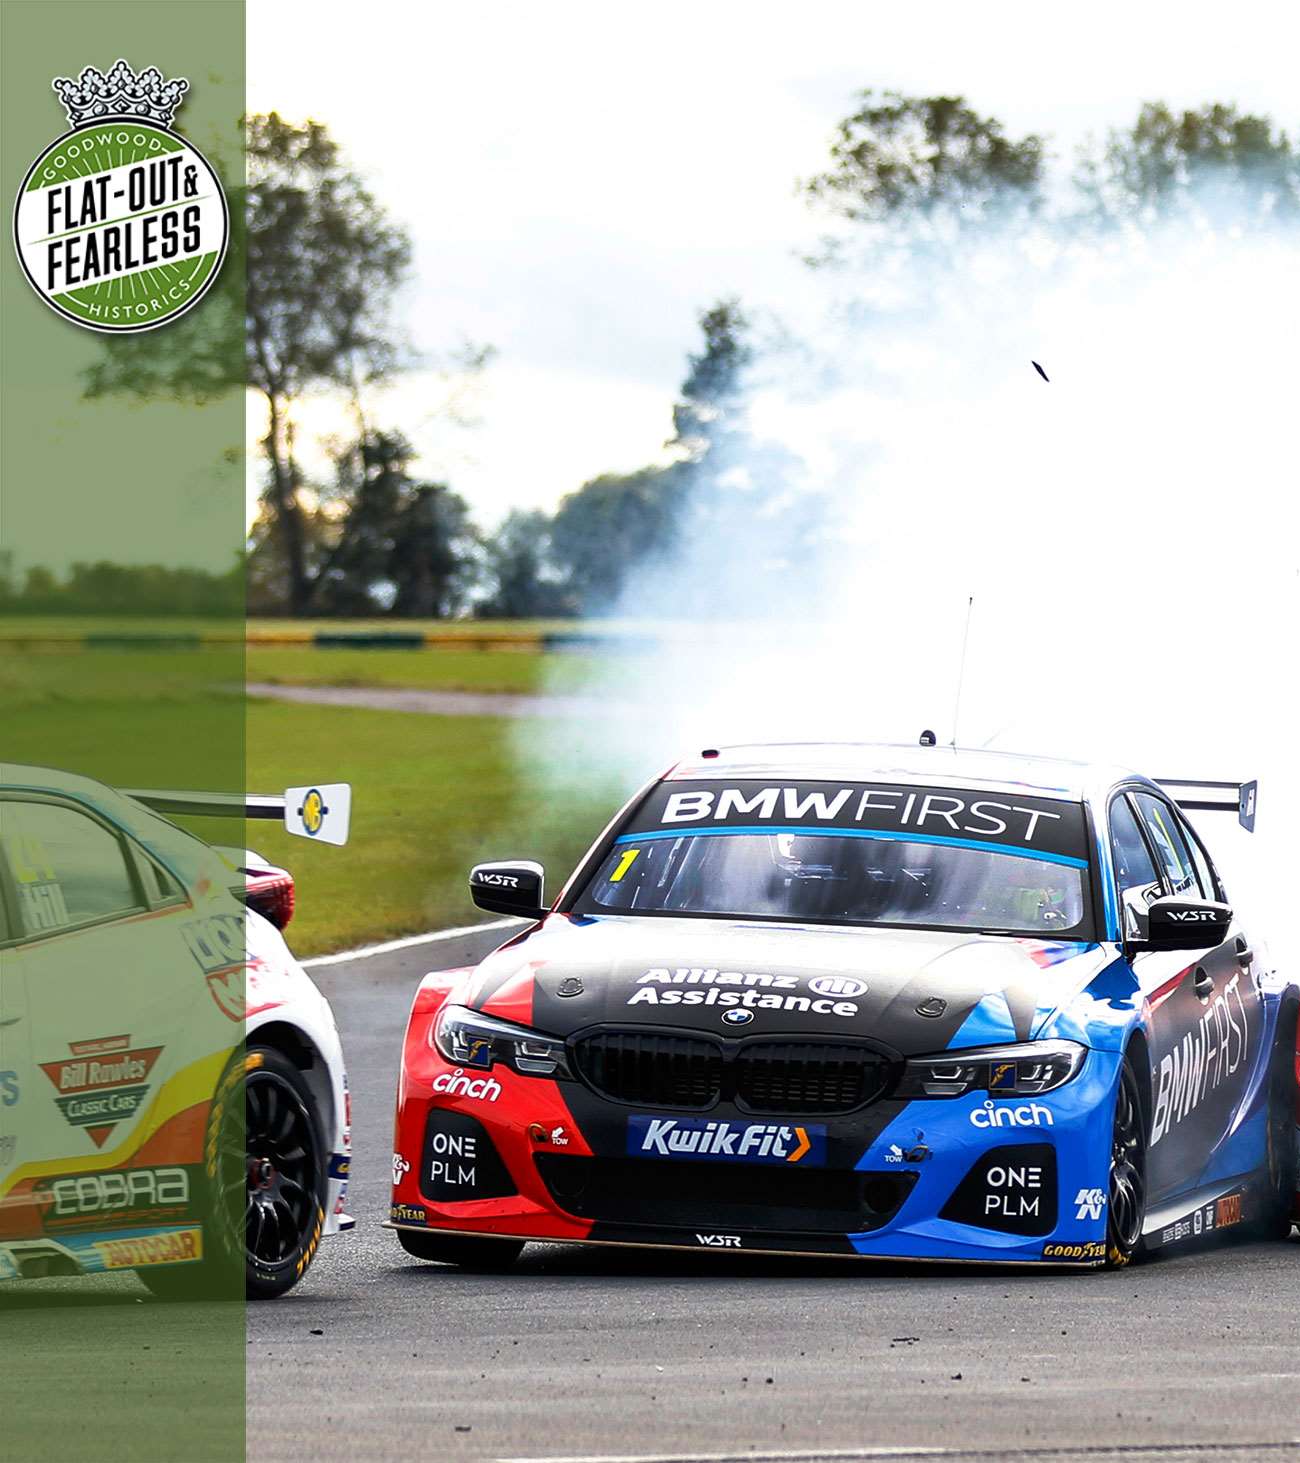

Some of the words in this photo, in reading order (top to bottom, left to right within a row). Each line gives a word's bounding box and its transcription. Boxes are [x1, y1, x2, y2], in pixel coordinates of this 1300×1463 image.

[610, 849, 639, 883] 1
[478, 872, 519, 888] WSR
[1167, 910, 1217, 921] WSR
[636, 968, 800, 989] Allianz
[627, 987, 859, 1017] Assistance
[432, 1068, 502, 1102] cinch
[970, 1100, 1054, 1128] cinch
[433, 1133, 476, 1158] ONE
[552, 1137, 568, 1146] TOW
[885, 1154, 902, 1164] TOW
[431, 1161, 475, 1186] PLM
[987, 1167, 1041, 1188] ONE
[53, 1168, 189, 1214] COBRA
[985, 1195, 1039, 1217] PLM
[696, 1234, 742, 1248] WSR
